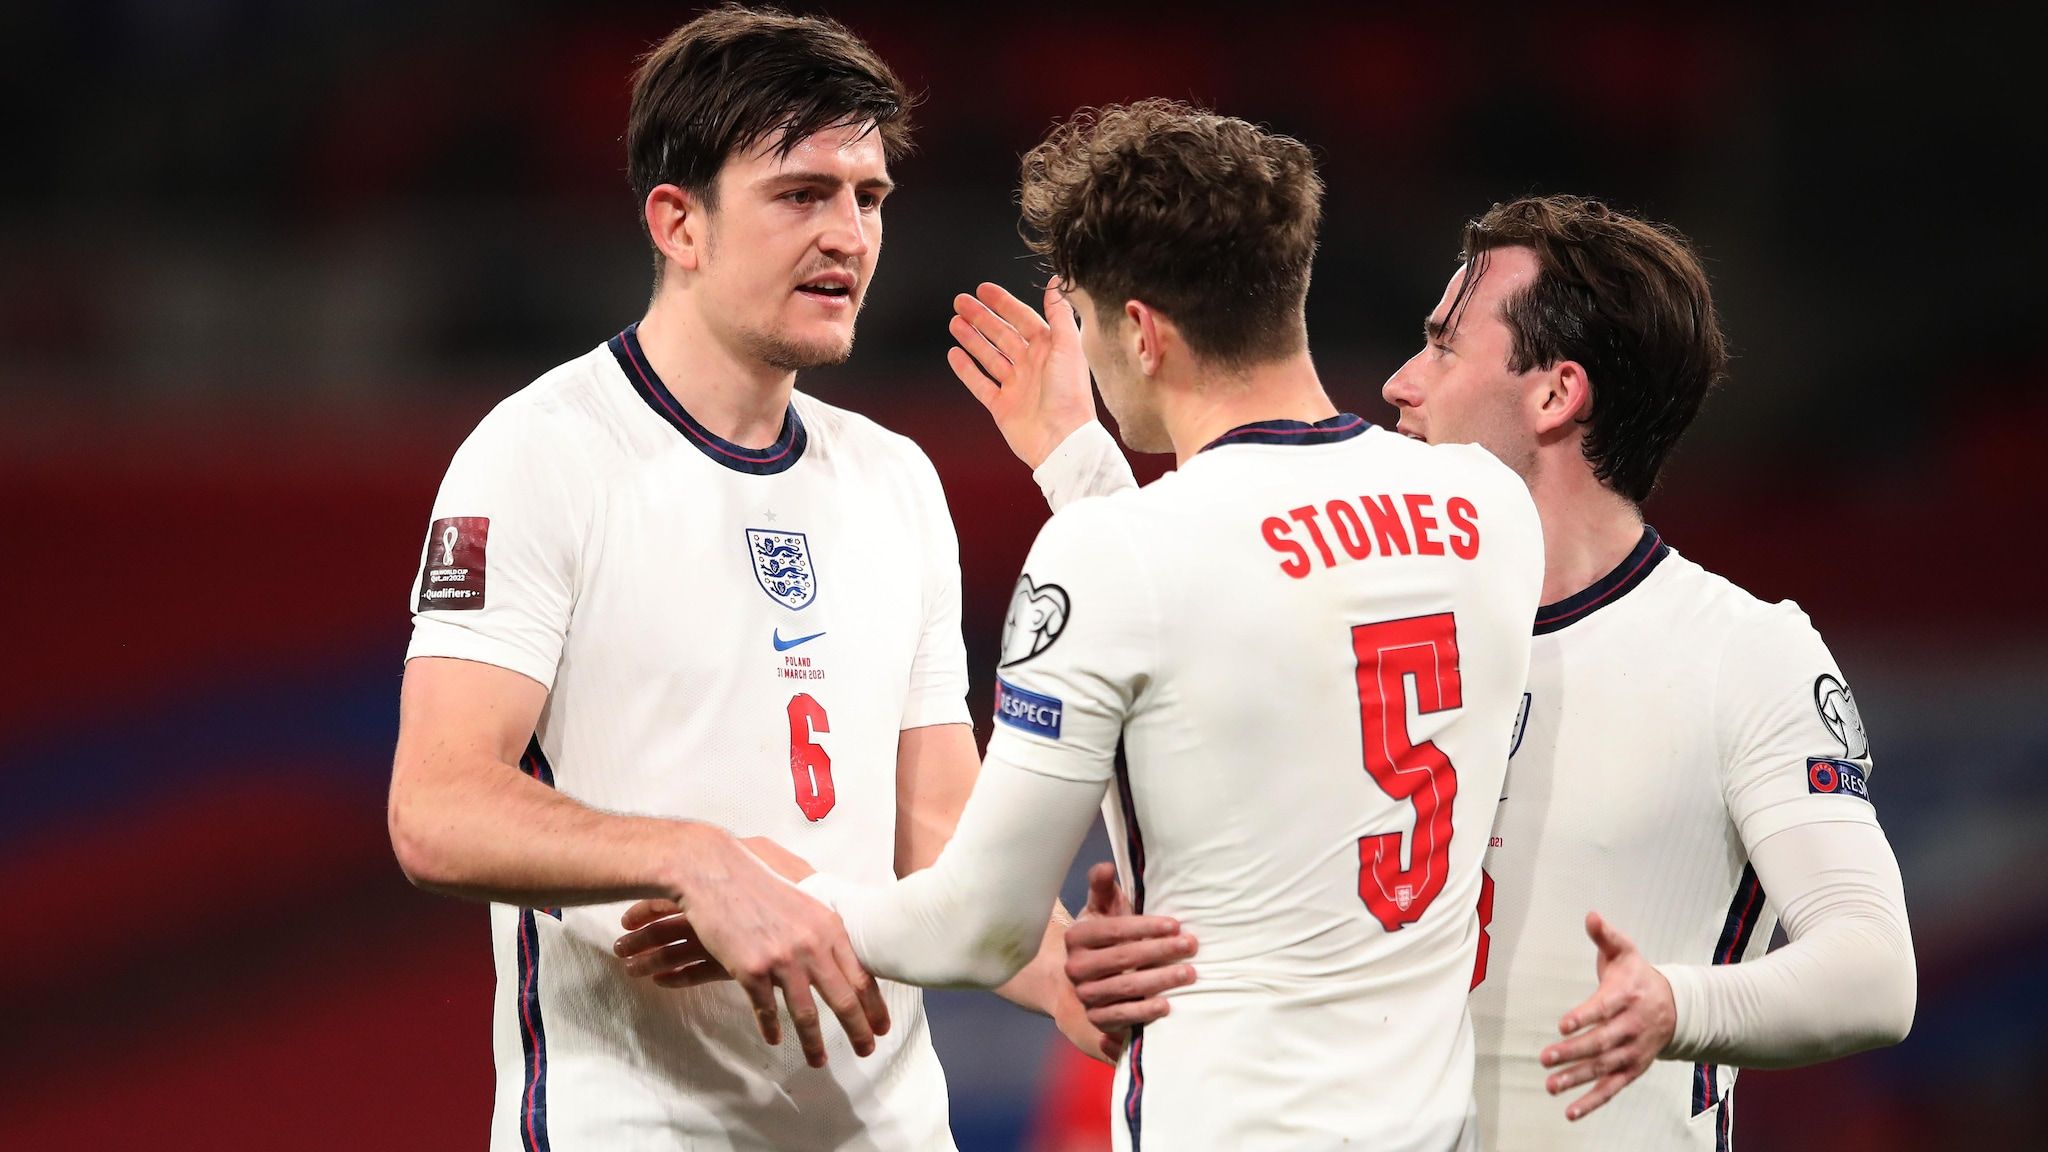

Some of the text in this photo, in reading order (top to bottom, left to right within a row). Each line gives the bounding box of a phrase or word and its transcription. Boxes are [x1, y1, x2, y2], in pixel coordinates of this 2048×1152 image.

[1261, 493, 1480, 579] STONES
[426, 588, 471, 600] Qualifiers
[785, 656, 811, 667] POLAND
[784, 669, 807, 679] MARCH
[808, 669, 825, 680] 2021
[787, 693, 835, 822] 6
[1351, 611, 1462, 932] 5
[1488, 836, 1503, 847] 021
